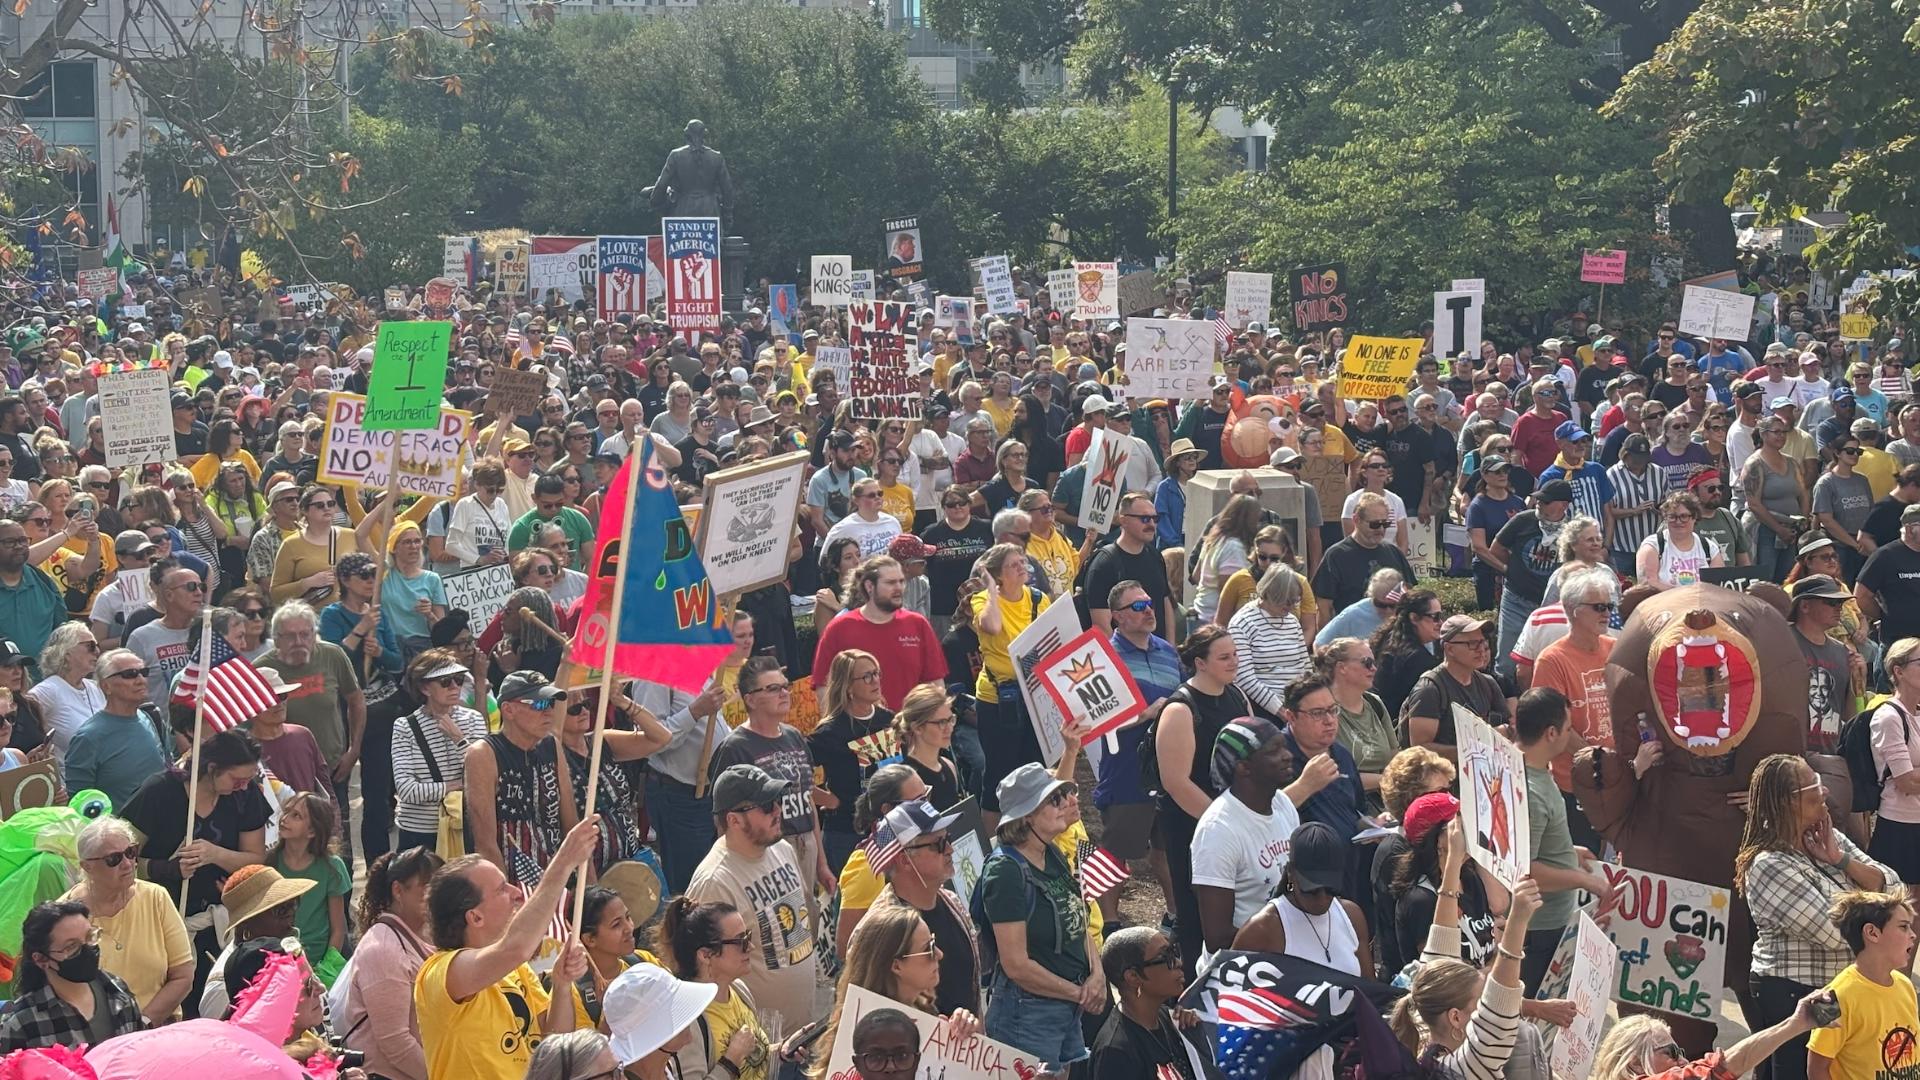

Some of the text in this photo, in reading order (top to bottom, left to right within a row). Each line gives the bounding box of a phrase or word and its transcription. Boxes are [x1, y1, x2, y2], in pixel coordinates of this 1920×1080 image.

[667, 222, 716, 231] STAND UP
[886, 219, 917, 231] FASCIST
[682, 231, 702, 239] FOR
[606, 242, 639, 255] LOVE
[668, 240, 716, 255] AMERICA
[500, 260, 525, 273] Free
[600, 255, 644, 269] AMERICA
[820, 262, 843, 277] NO
[287, 285, 312, 293] SWEET
[813, 279, 851, 295] KINGS
[1301, 270, 1338, 296] NO
[674, 302, 714, 313] FIGHT
[1077, 305, 1112, 315] TRUMP
[1295, 293, 1348, 330] KINGS
[670, 314, 719, 328] TRUMPISM
[1843, 321, 1875, 334] DICTAT
[384, 331, 440, 355] Respect
[1356, 343, 1411, 360] NO ONE IS
[1131, 358, 1200, 372] ARREST
[1363, 360, 1391, 373] FREE
[1158, 378, 1195, 392] ICE
[1340, 371, 1408, 384] WHEN OTHERS ARE
[1344, 382, 1396, 397] OPPRESSED
[364, 396, 437, 422] Amendment
[332, 427, 467, 455] DEMOCRACY
[329, 449, 372, 471] NO
[364, 470, 458, 497] AUOCRATS
[723, 476, 792, 500] THEY SACRIFICED THEIR
[731, 494, 748, 503] LIVES
[758, 487, 774, 498] THAT
[749, 496, 762, 504] LIVE
[763, 492, 777, 500] FREE
[1092, 486, 1111, 512] NO
[1088, 510, 1106, 525] KINGS
[475, 527, 486, 536] NO
[711, 537, 778, 563] WE WILL NOT LIVE
[718, 547, 772, 568] ON OUR KNEES
[119, 575, 139, 602] NO
[452, 568, 511, 593] WE WON
[451, 582, 516, 608] GO BACKWA
[1076, 674, 1114, 711] NO
[1089, 696, 1120, 721] KINGS
[782, 790, 812, 819] ESIS
[745, 862, 800, 911] PACERS
[1602, 863, 1668, 929] YOU
[1669, 904, 1725, 945] can
[1620, 960, 1712, 1018] Lands
[923, 1022, 1008, 1076] AMERICA
